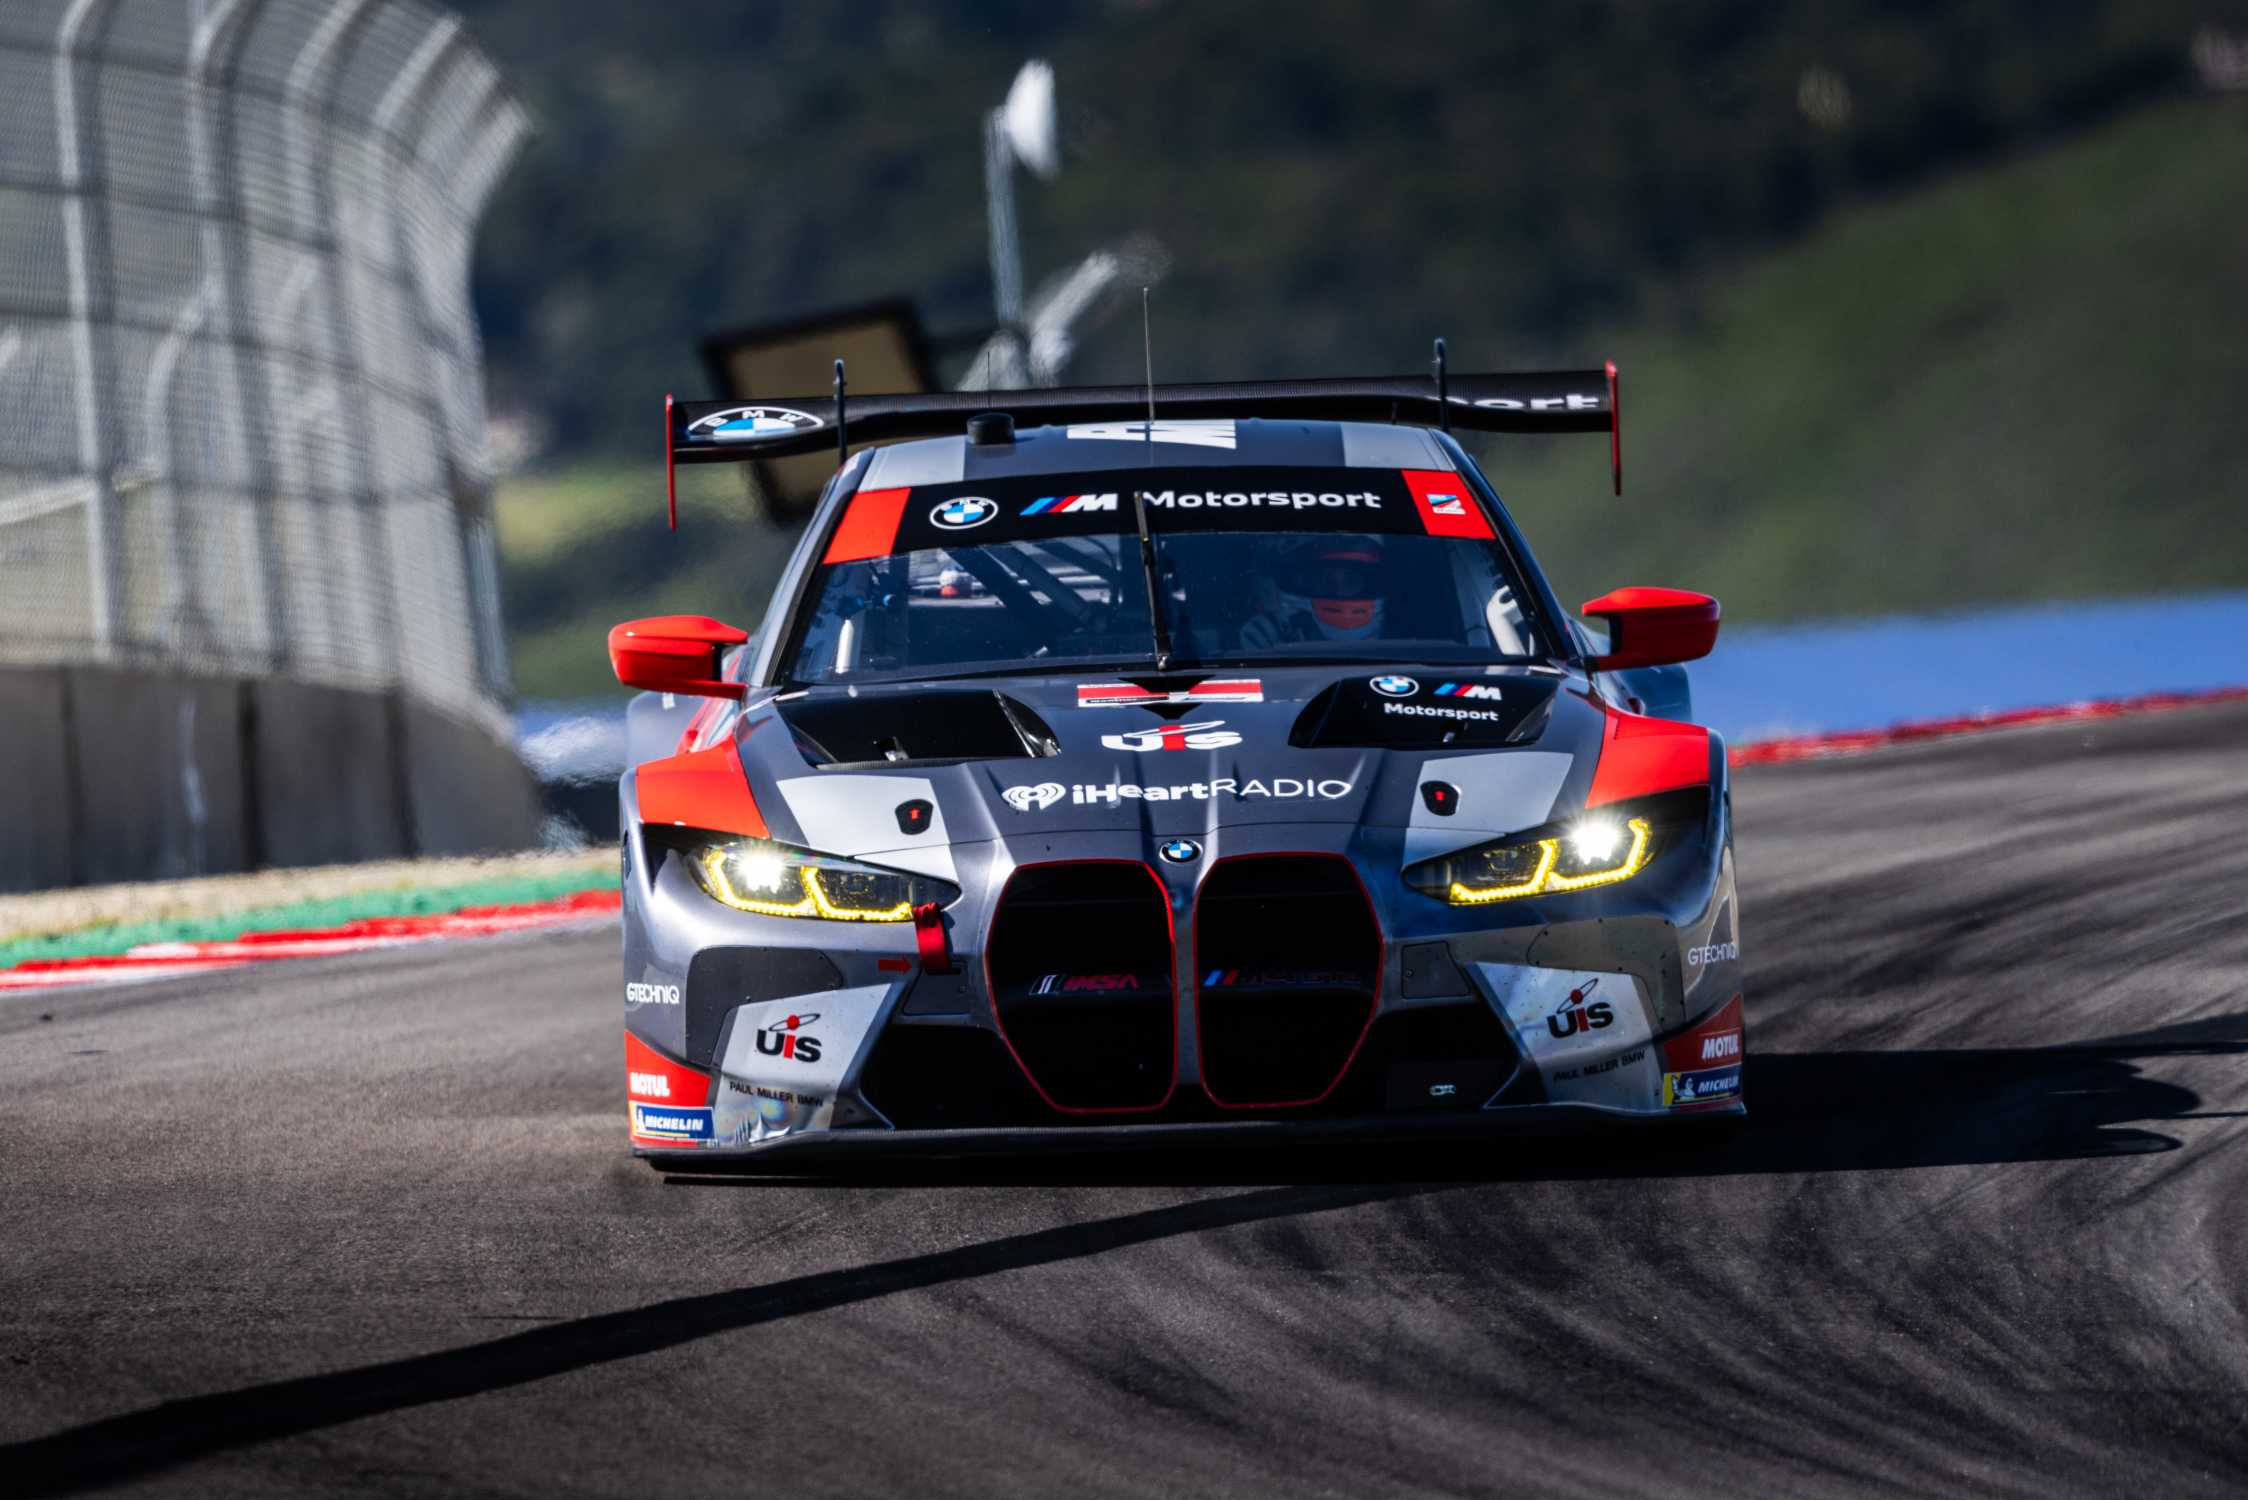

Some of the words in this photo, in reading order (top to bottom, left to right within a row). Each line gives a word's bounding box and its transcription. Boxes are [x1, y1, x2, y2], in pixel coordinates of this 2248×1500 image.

[704, 409, 804, 428] BMW
[1142, 491, 1382, 509] Motorsport
[1384, 702, 1499, 721] Motorsport
[1072, 779, 1351, 804] iHeartRADIO
[626, 983, 680, 1004] GTECHNIQ
[1702, 1033, 1739, 1060] MOTUL
[1621, 1049, 1646, 1066] BMW
[630, 1072, 671, 1097] MOTUL
[729, 1081, 753, 1096] PAUL
[757, 1087, 794, 1104] MILLER
[645, 1114, 704, 1131] MICHELIN
